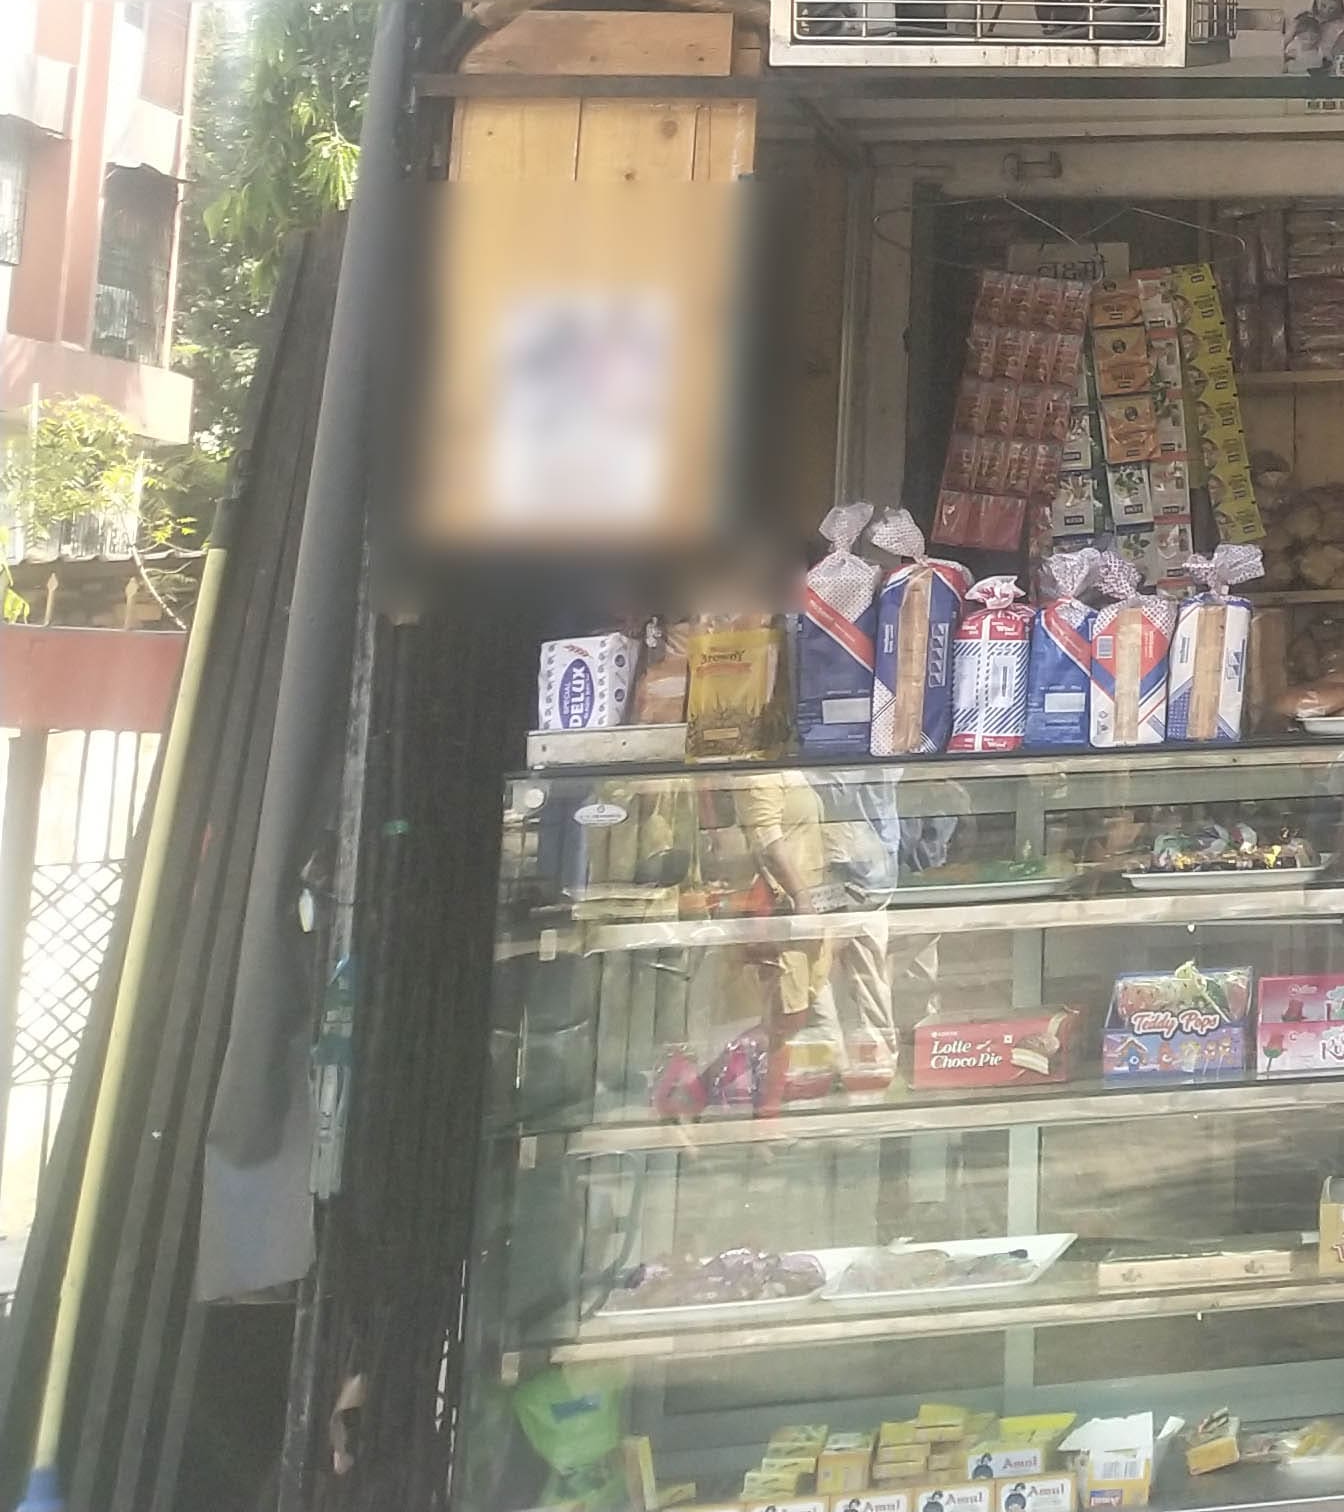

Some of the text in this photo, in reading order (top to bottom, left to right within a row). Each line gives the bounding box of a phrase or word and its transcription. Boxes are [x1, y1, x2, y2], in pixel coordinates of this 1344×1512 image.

[569, 666, 586, 728] DELUX
[931, 1040, 972, 1055] Lotte
[930, 1052, 1003, 1070] Choco Pie
[1002, 1455, 1038, 1469] Amul
[1027, 1483, 1065, 1498] Amul
[944, 1491, 983, 1506] Amul
